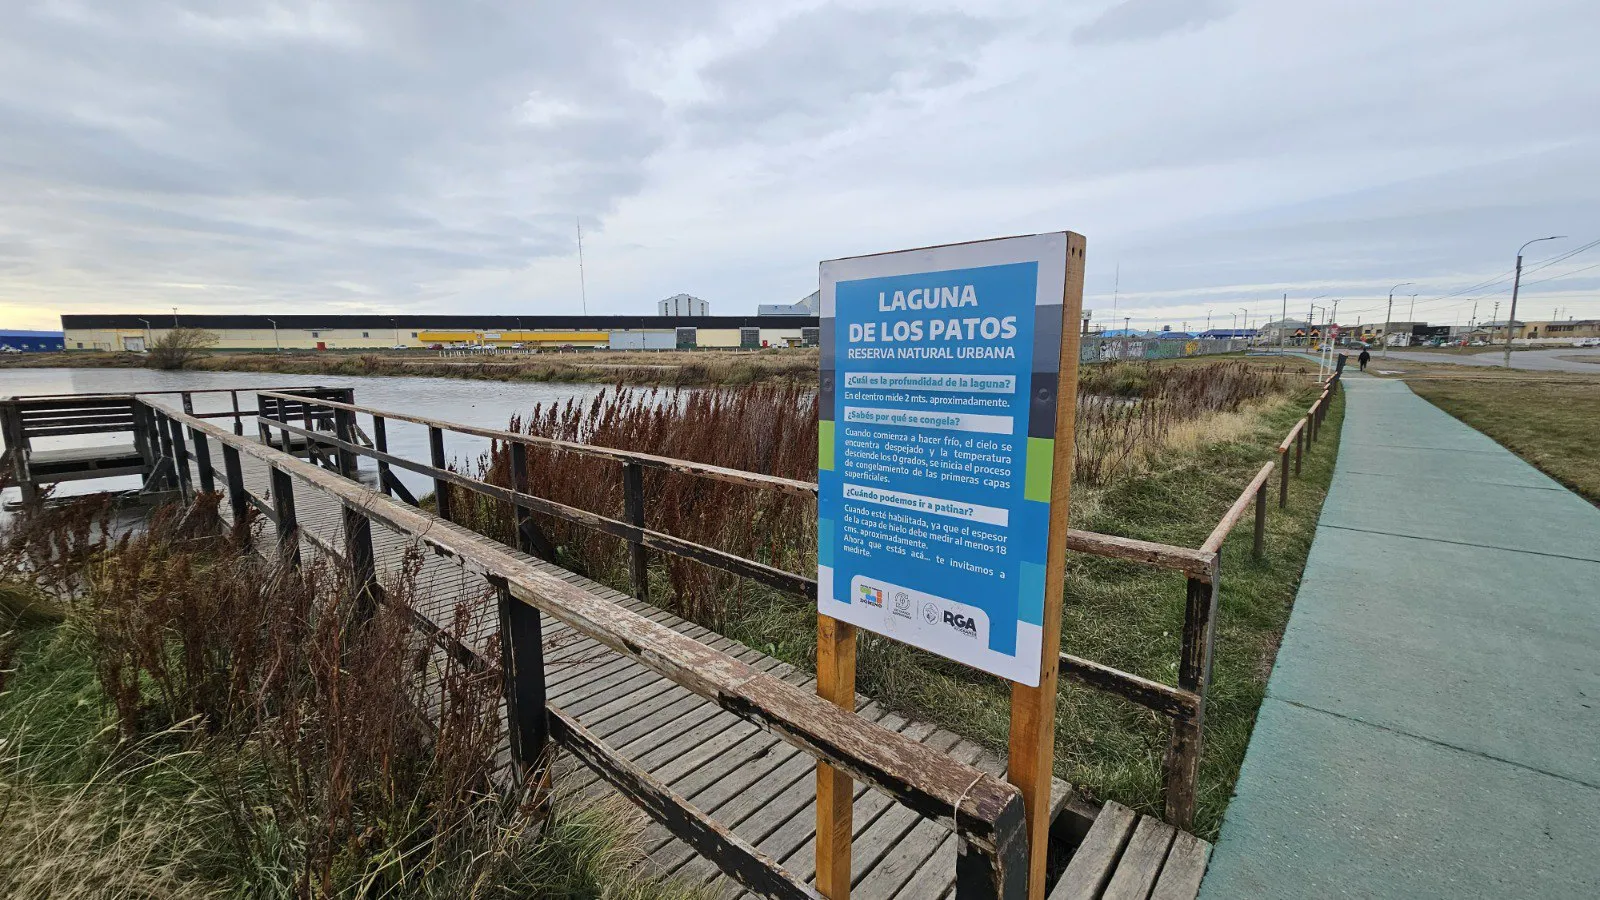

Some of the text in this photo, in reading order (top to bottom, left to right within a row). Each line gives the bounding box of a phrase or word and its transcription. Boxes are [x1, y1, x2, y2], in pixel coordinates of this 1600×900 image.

[879, 284, 978, 312] LAGUNA
[850, 316, 1017, 342] DE LOS PATOS
[848, 346, 1015, 358] RESERVA NATURAL URBANA
[848, 376, 868, 385] ¿Cuál
[880, 376, 887, 384] la
[890, 376, 943, 386] profundidad
[946, 378, 956, 386] de
[960, 378, 968, 386] la
[971, 378, 1010, 390] laguna?
[886, 392, 903, 402] mide
[905, 394, 910, 402] 2
[911, 395, 928, 403] mts.
[930, 396, 1010, 407] aproximadamente.
[848, 411, 873, 419] ¿Sabés
[891, 414, 906, 423] qué
[920, 417, 960, 426] congela?
[845, 428, 870, 437] Cuando
[874, 432, 908, 441] comienza
[918, 434, 941, 444] hacer
[944, 436, 962, 448] frío,
[965, 439, 972, 448] el
[977, 440, 997, 450] cielo
[845, 440, 1011, 464] encuentra despejado y la temperatura
[845, 448, 878, 460] desciende
[881, 452, 891, 461] los
[899, 456, 928, 467] grados,
[941, 460, 962, 470] inicia
[965, 463, 972, 471] el
[974, 466, 1011, 476] proceso
[845, 471, 890, 482] superficiales.
[856, 462, 909, 474] congelamiento
[913, 468, 922, 476] de
[926, 469, 937, 478] las
[941, 473, 979, 484] primeras
[984, 479, 1010, 489] capas
[847, 488, 877, 499] ¿Cuándo
[880, 495, 917, 506] podemos
[935, 504, 973, 516] patinar?
[844, 504, 869, 515] Cuando
[888, 512, 928, 528] habilitada,
[943, 525, 959, 533] que
[962, 527, 969, 535] el
[972, 531, 1007, 542] espesor
[844, 514, 852, 522] de
[854, 515, 859, 524] la
[861, 519, 877, 527] capa
[889, 523, 906, 533] hielo
[909, 527, 927, 537] debe
[930, 533, 953, 543] medir
[965, 540, 994, 552] menos
[996, 545, 1006, 555] 18
[860, 529, 928, 549] aproximadamente.
[844, 545, 872, 557] medirte.
[844, 534, 863, 545] Ahora
[869, 541, 882, 549] que
[886, 545, 906, 555] estás
[911, 551, 930, 560] acá...
[936, 555, 944, 564] te
[950, 558, 994, 576] invitamos
[944, 610, 976, 632] RGA
